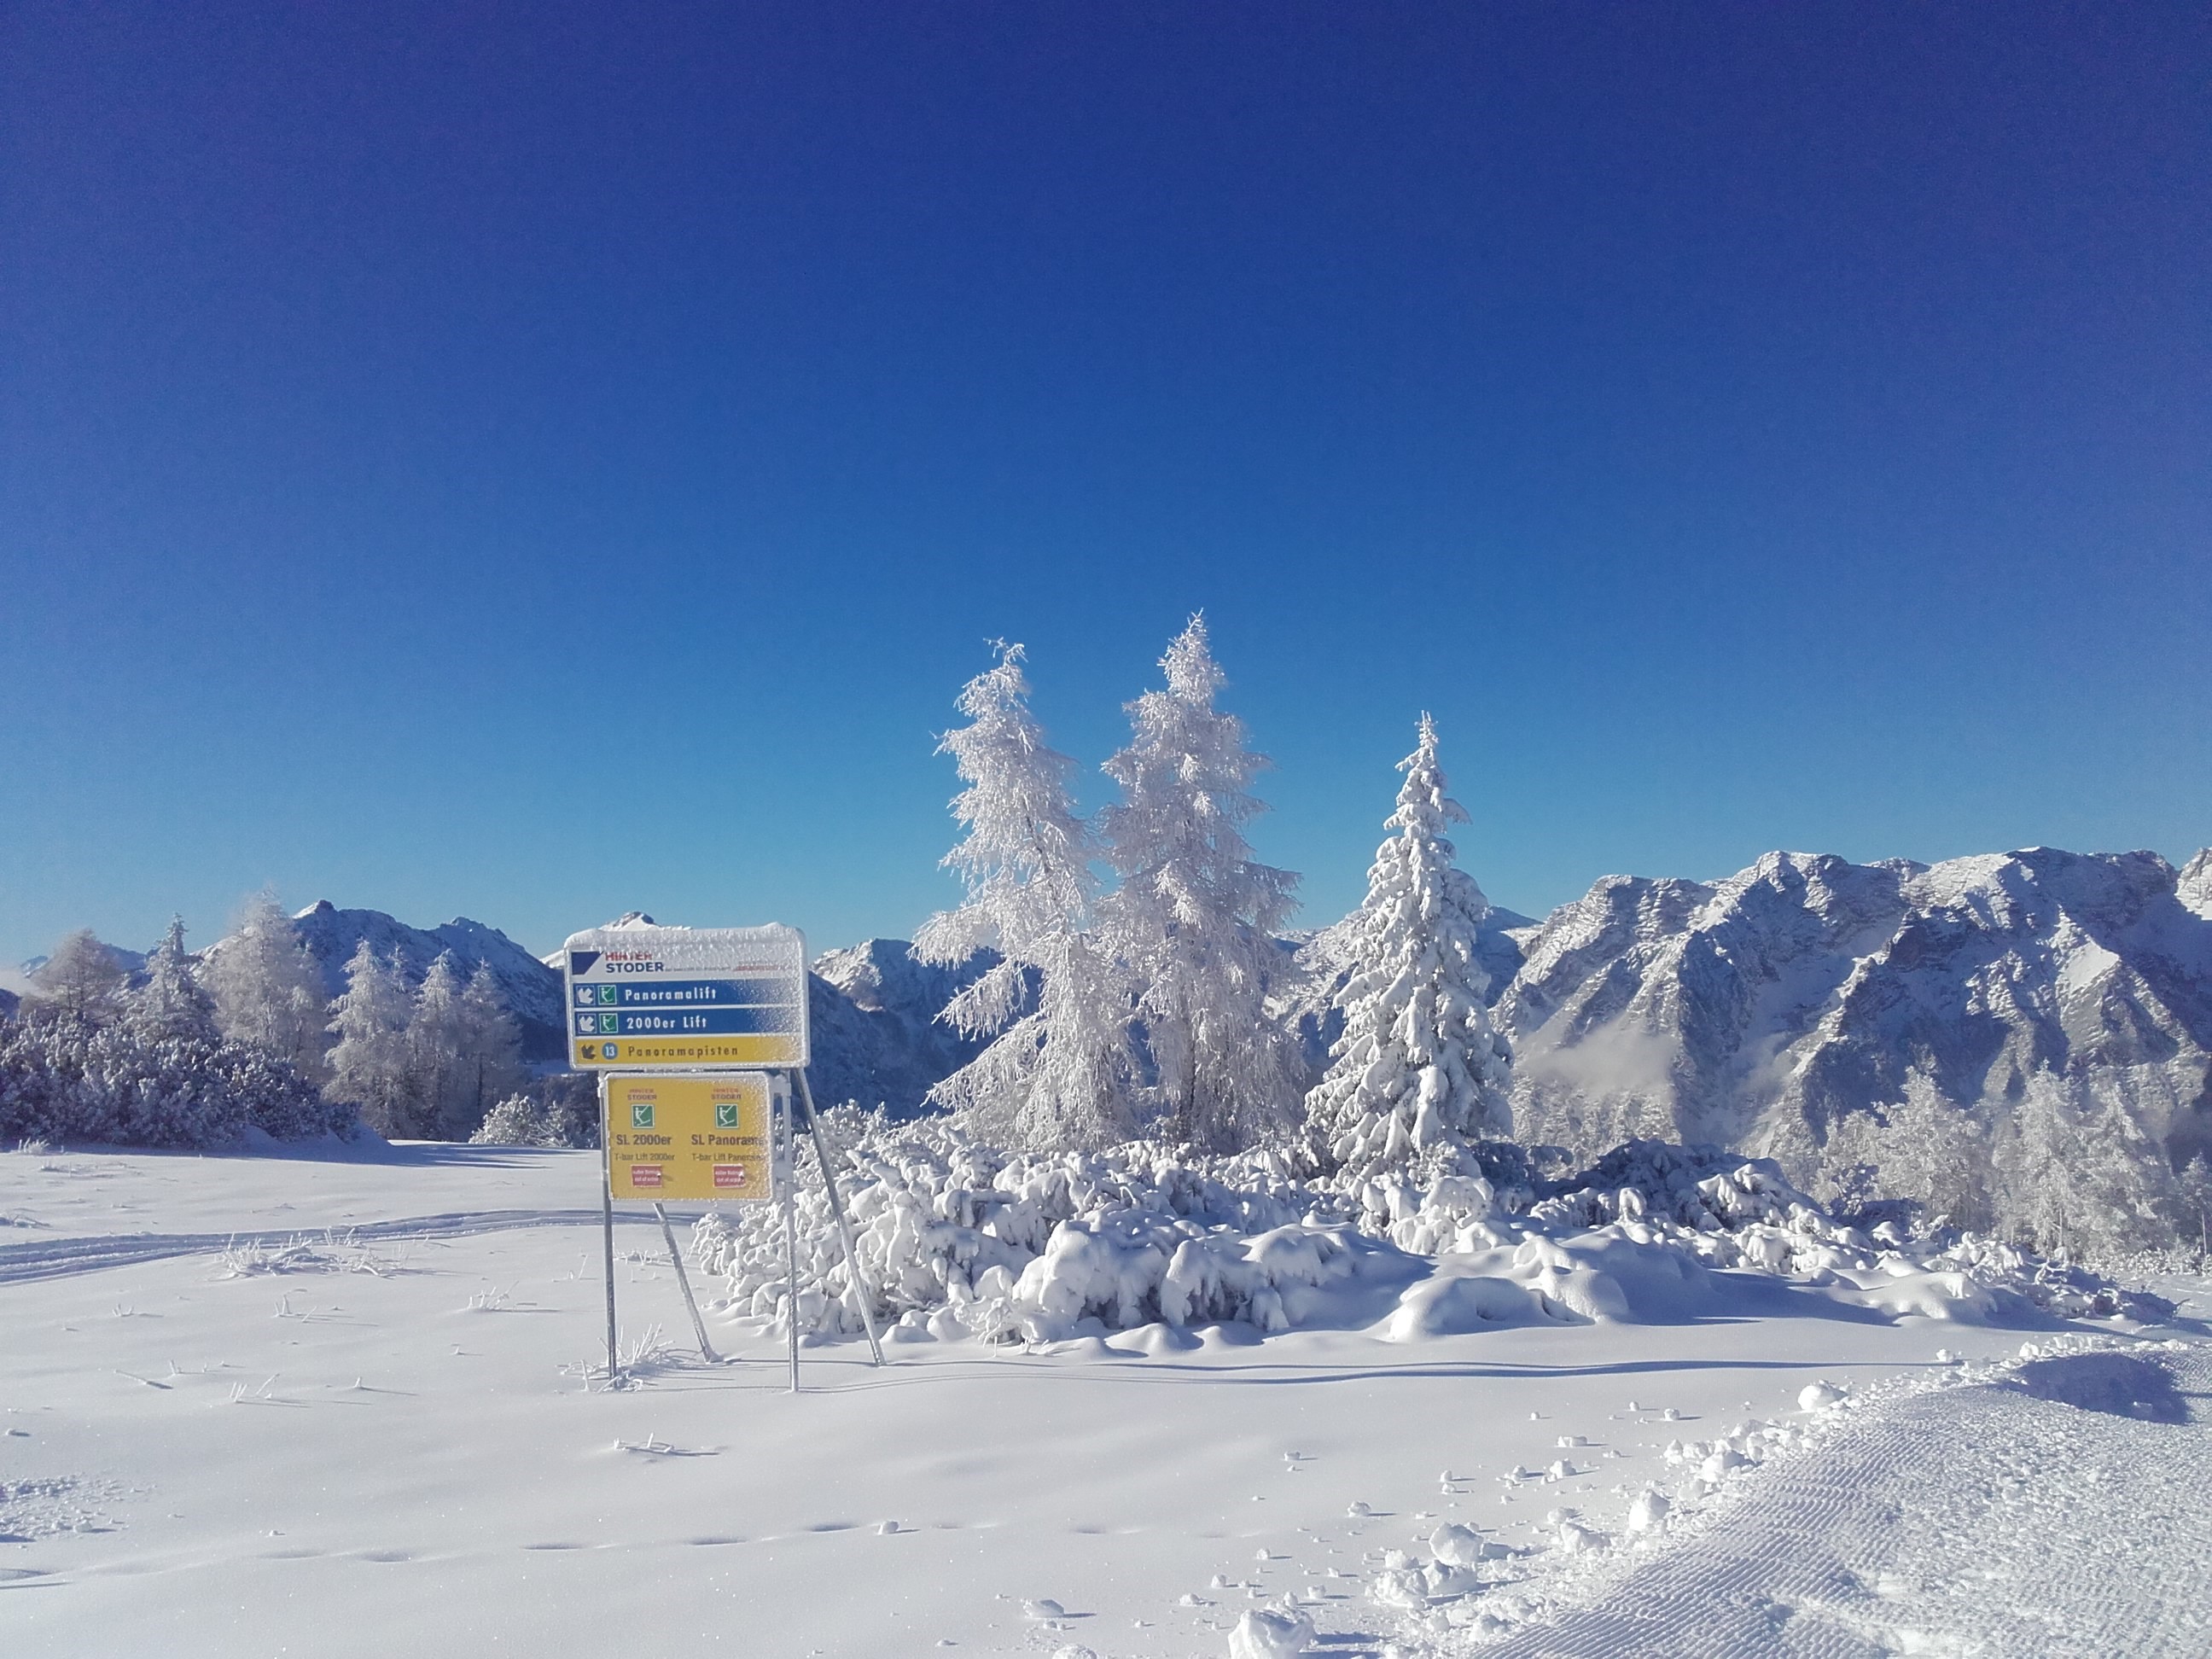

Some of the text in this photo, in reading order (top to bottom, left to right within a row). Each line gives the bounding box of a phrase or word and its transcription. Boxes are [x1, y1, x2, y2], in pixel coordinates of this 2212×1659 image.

[606, 962, 664, 973] STODER
[625, 986, 717, 1001] Panoramalift
[626, 1015, 707, 1029] 2000er Lift
[605, 1045, 738, 1058] 13 Panoramapisten
[616, 1134, 672, 1145] SL 2000er
[691, 1134, 705, 1145] SL
